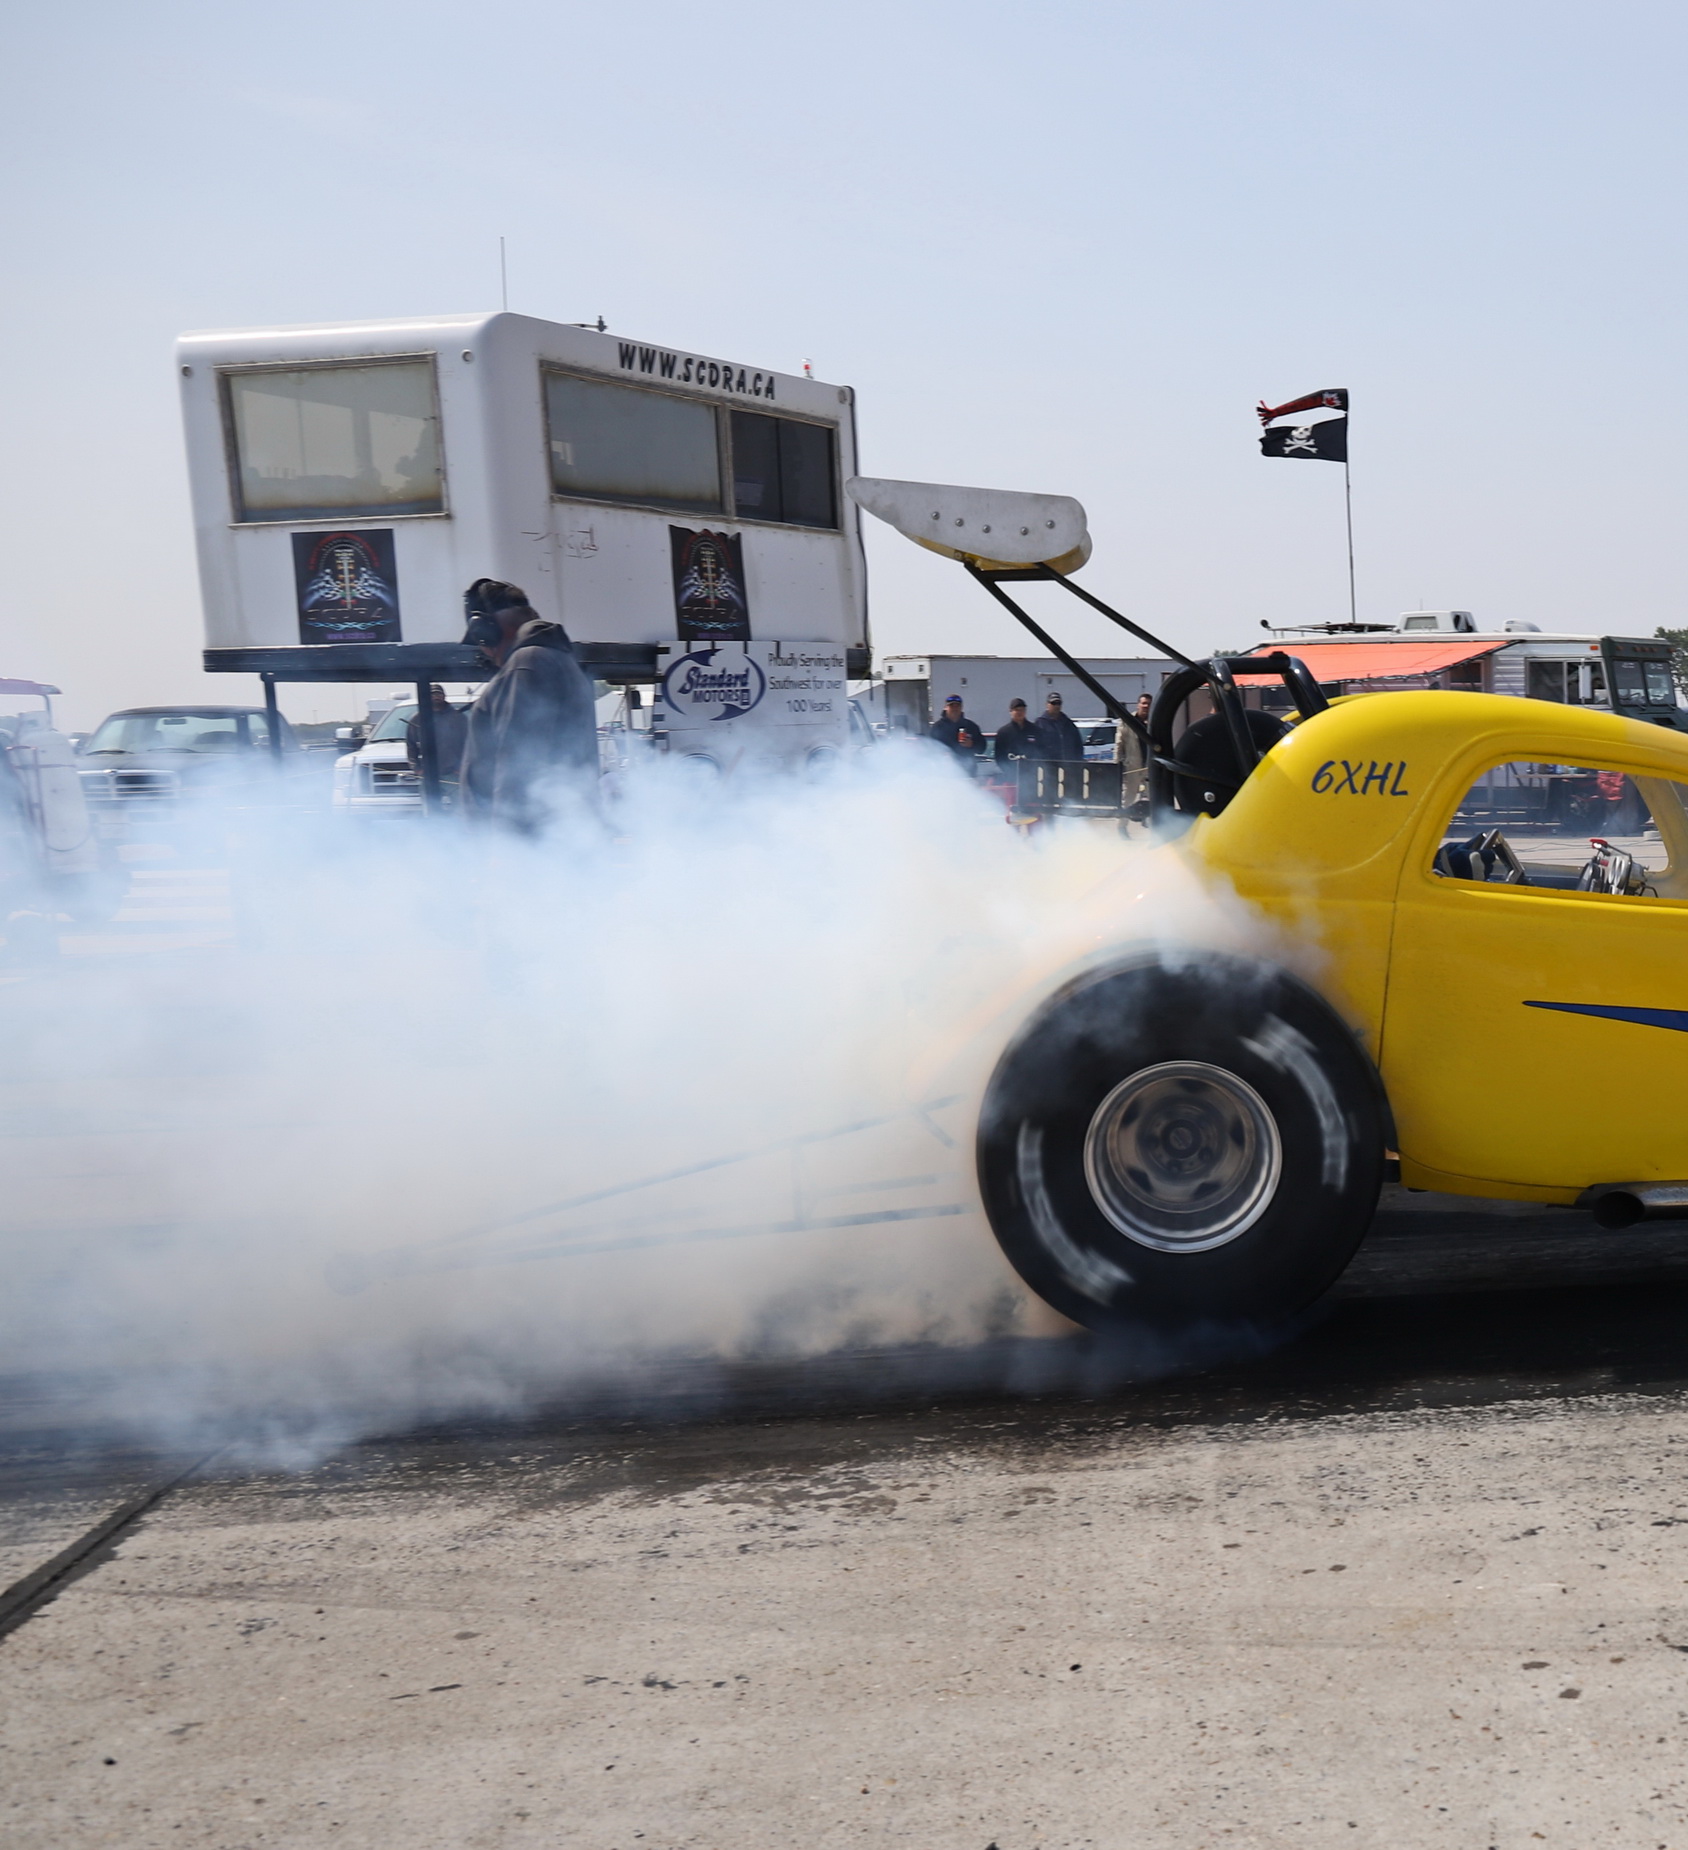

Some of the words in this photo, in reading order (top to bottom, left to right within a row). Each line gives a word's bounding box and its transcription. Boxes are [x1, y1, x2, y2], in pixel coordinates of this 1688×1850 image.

[618, 342, 775, 400] WWW.SCDRA.CA
[768, 653, 798, 669] Proudly
[799, 653, 829, 670] Serving
[830, 653, 844, 667] the
[677, 666, 750, 694] Standard
[768, 676, 812, 689] Southwest
[812, 676, 826, 691] for
[826, 680, 842, 689] over
[692, 689, 740, 703] MOTORS
[786, 699, 807, 712] 100
[1311, 760, 1409, 796] 6XHL
